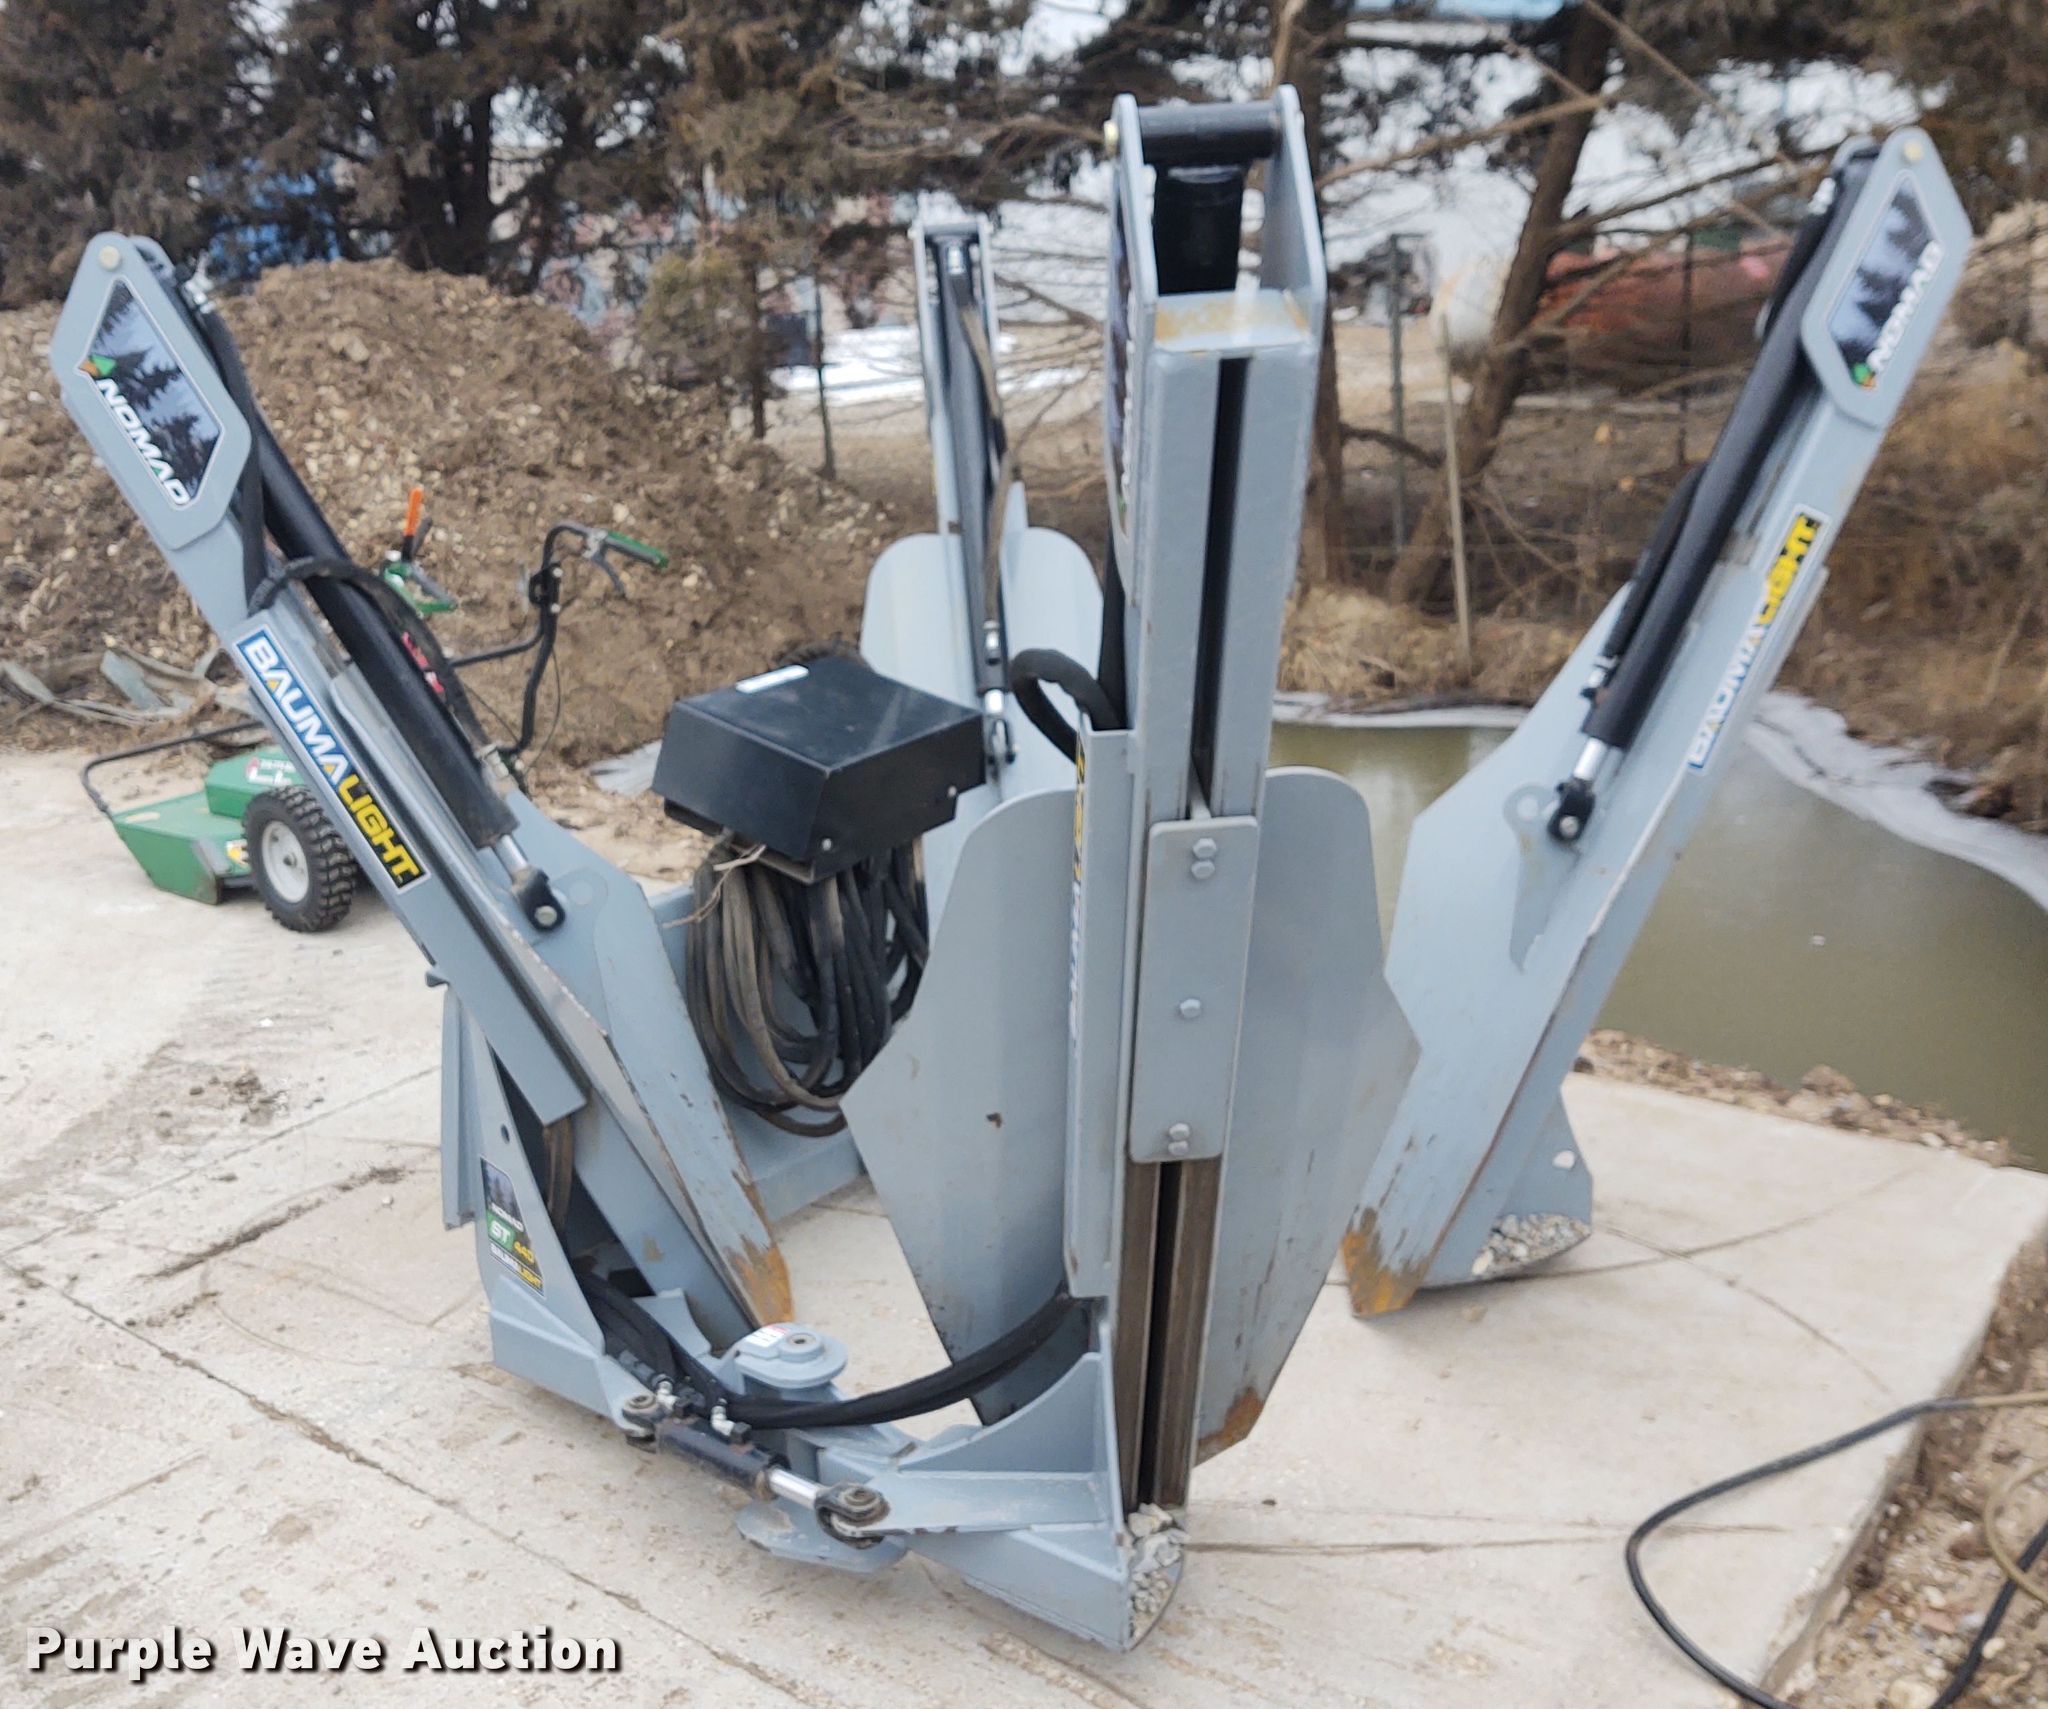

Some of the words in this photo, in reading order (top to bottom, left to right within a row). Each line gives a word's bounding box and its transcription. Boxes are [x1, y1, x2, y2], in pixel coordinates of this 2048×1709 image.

[1867, 240, 1945, 373] NOMAD
[97, 379, 190, 506] NOMAD
[244, 636, 421, 880] BAUMALIGHT
